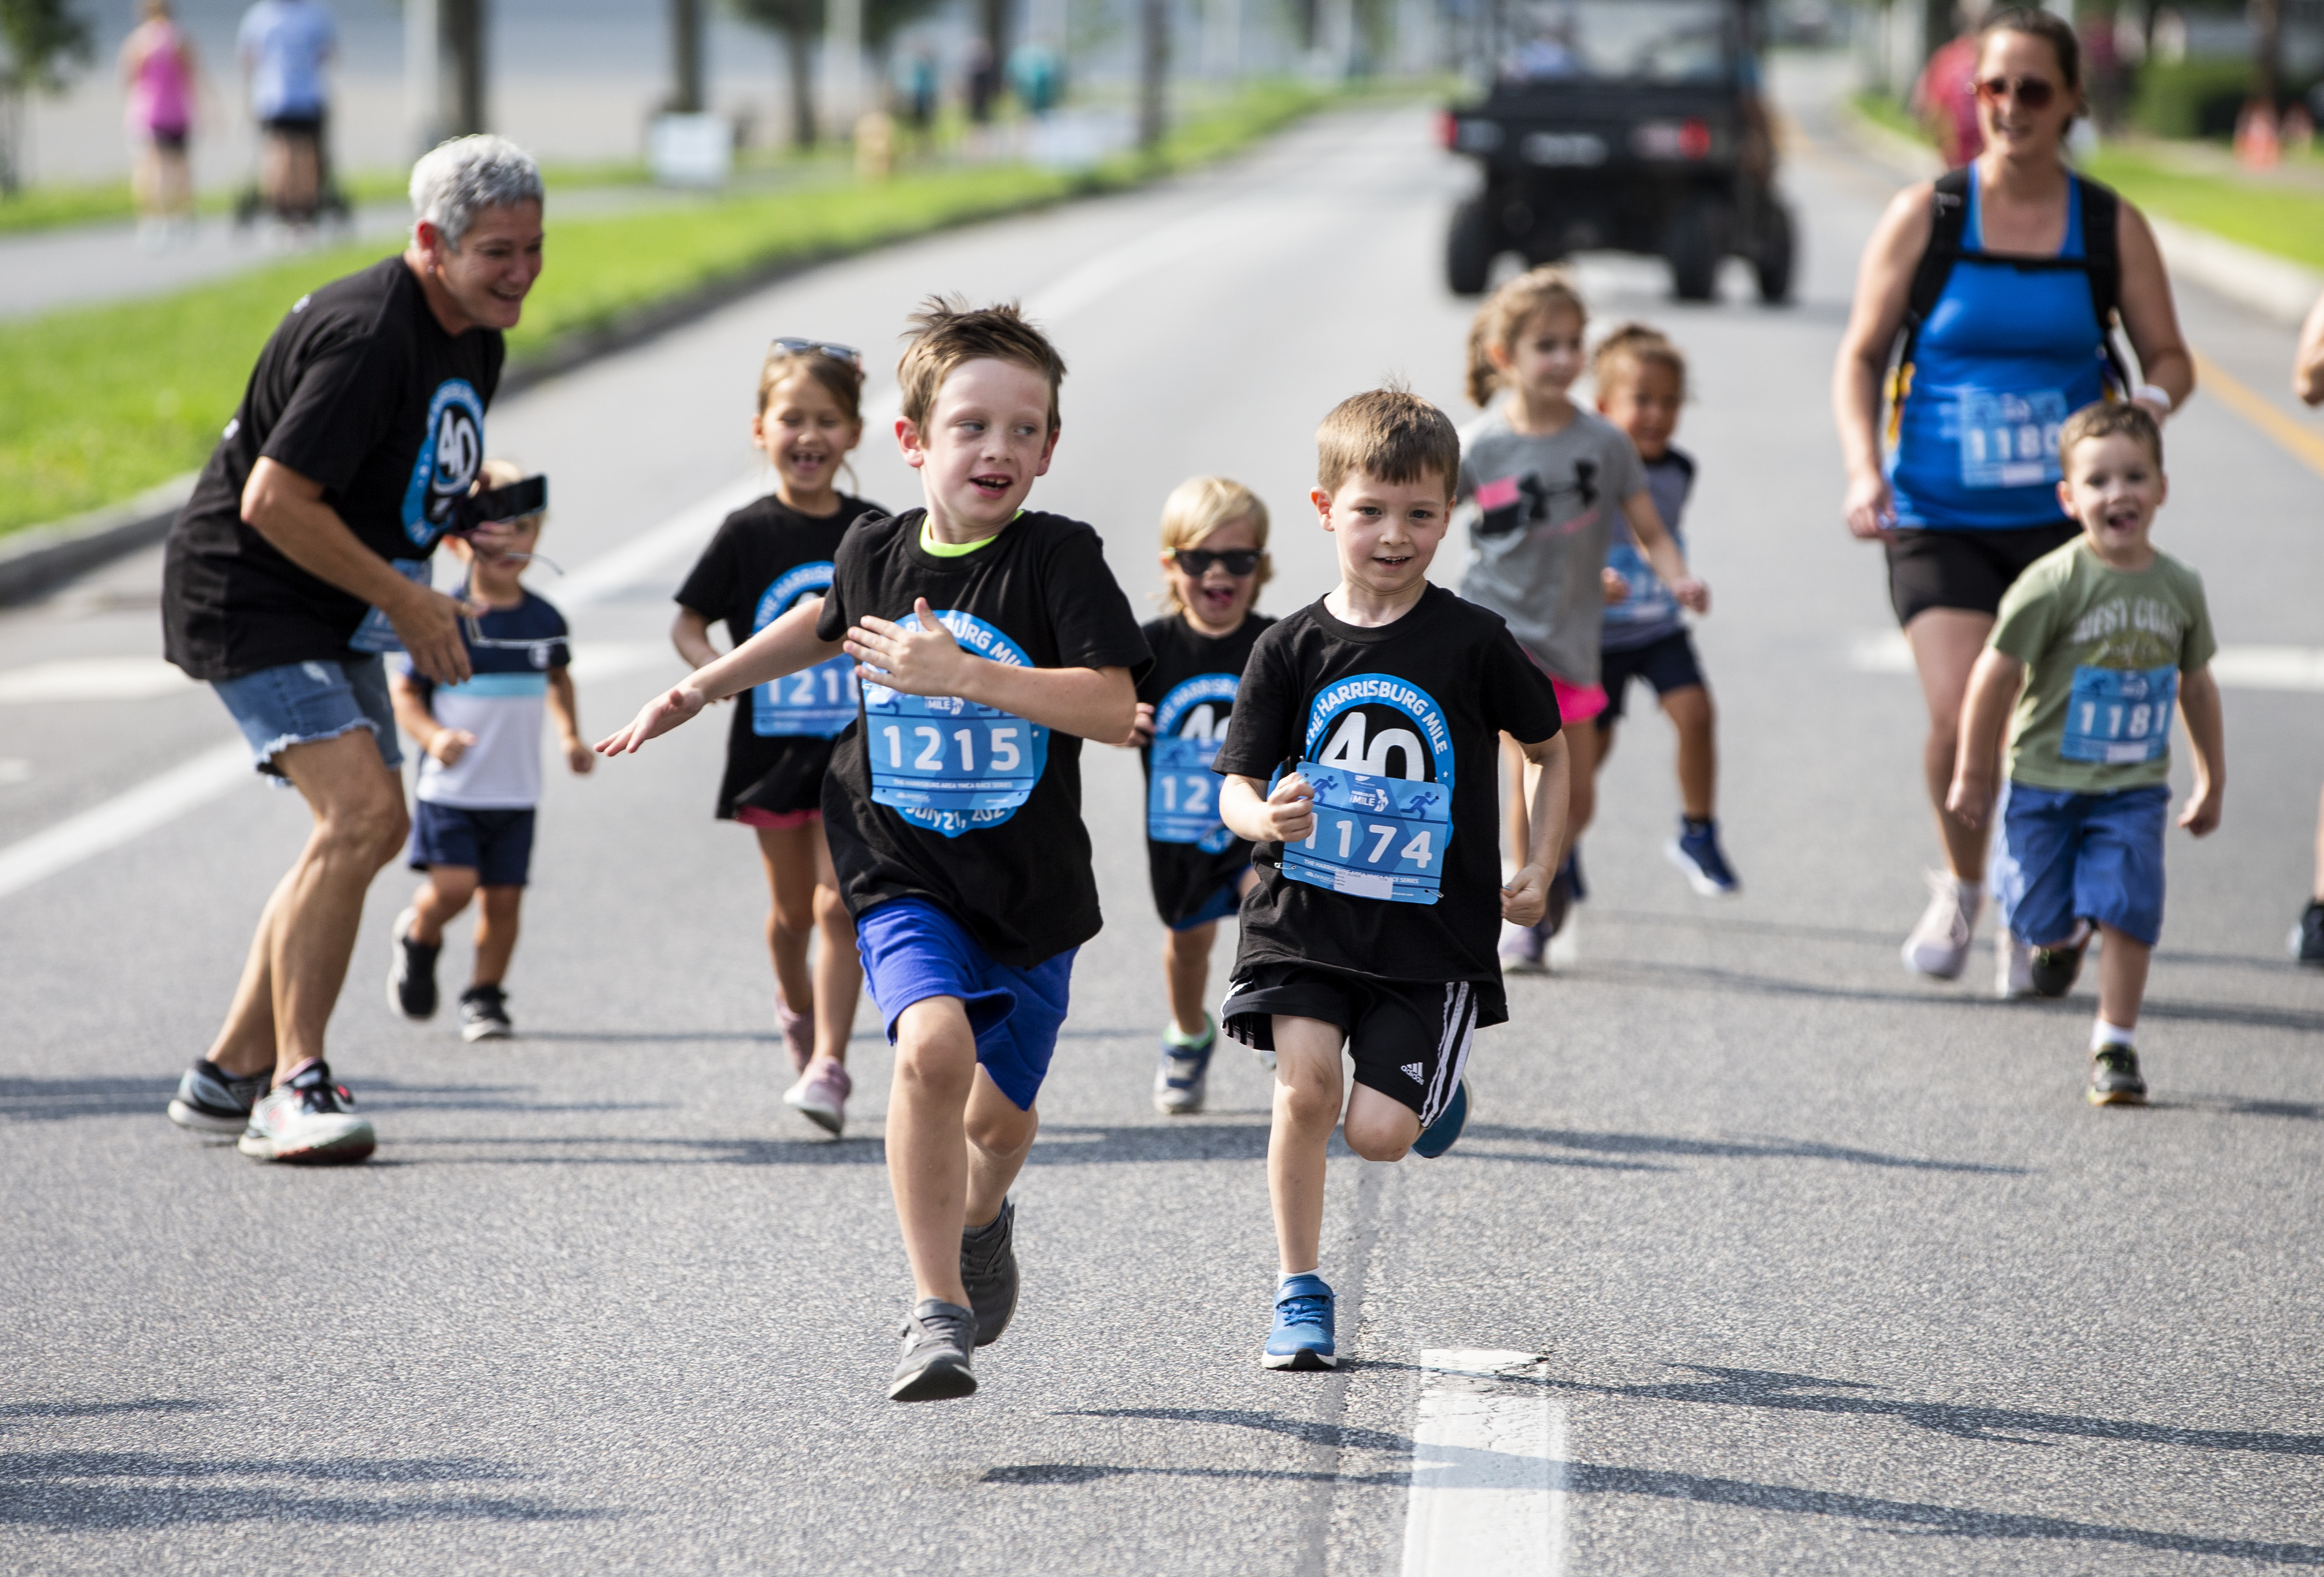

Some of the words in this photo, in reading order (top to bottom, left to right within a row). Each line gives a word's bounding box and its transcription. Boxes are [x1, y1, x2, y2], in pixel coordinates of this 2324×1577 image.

[437, 408, 478, 477] 40
[1306, 711, 1324, 746] THE
[1317, 680, 1429, 717] HARRISBURG
[1421, 711, 1448, 755] MILE
[2081, 700, 2169, 739] 1181
[883, 725, 1020, 772] 1215
[1319, 711, 1425, 782] 40
[971, 807, 1012, 822] 202
[1161, 775, 1210, 813] 12
[1352, 795, 1376, 806] MILE
[1304, 812, 1433, 868] 1174
[1401, 1065, 1424, 1085] adidas
